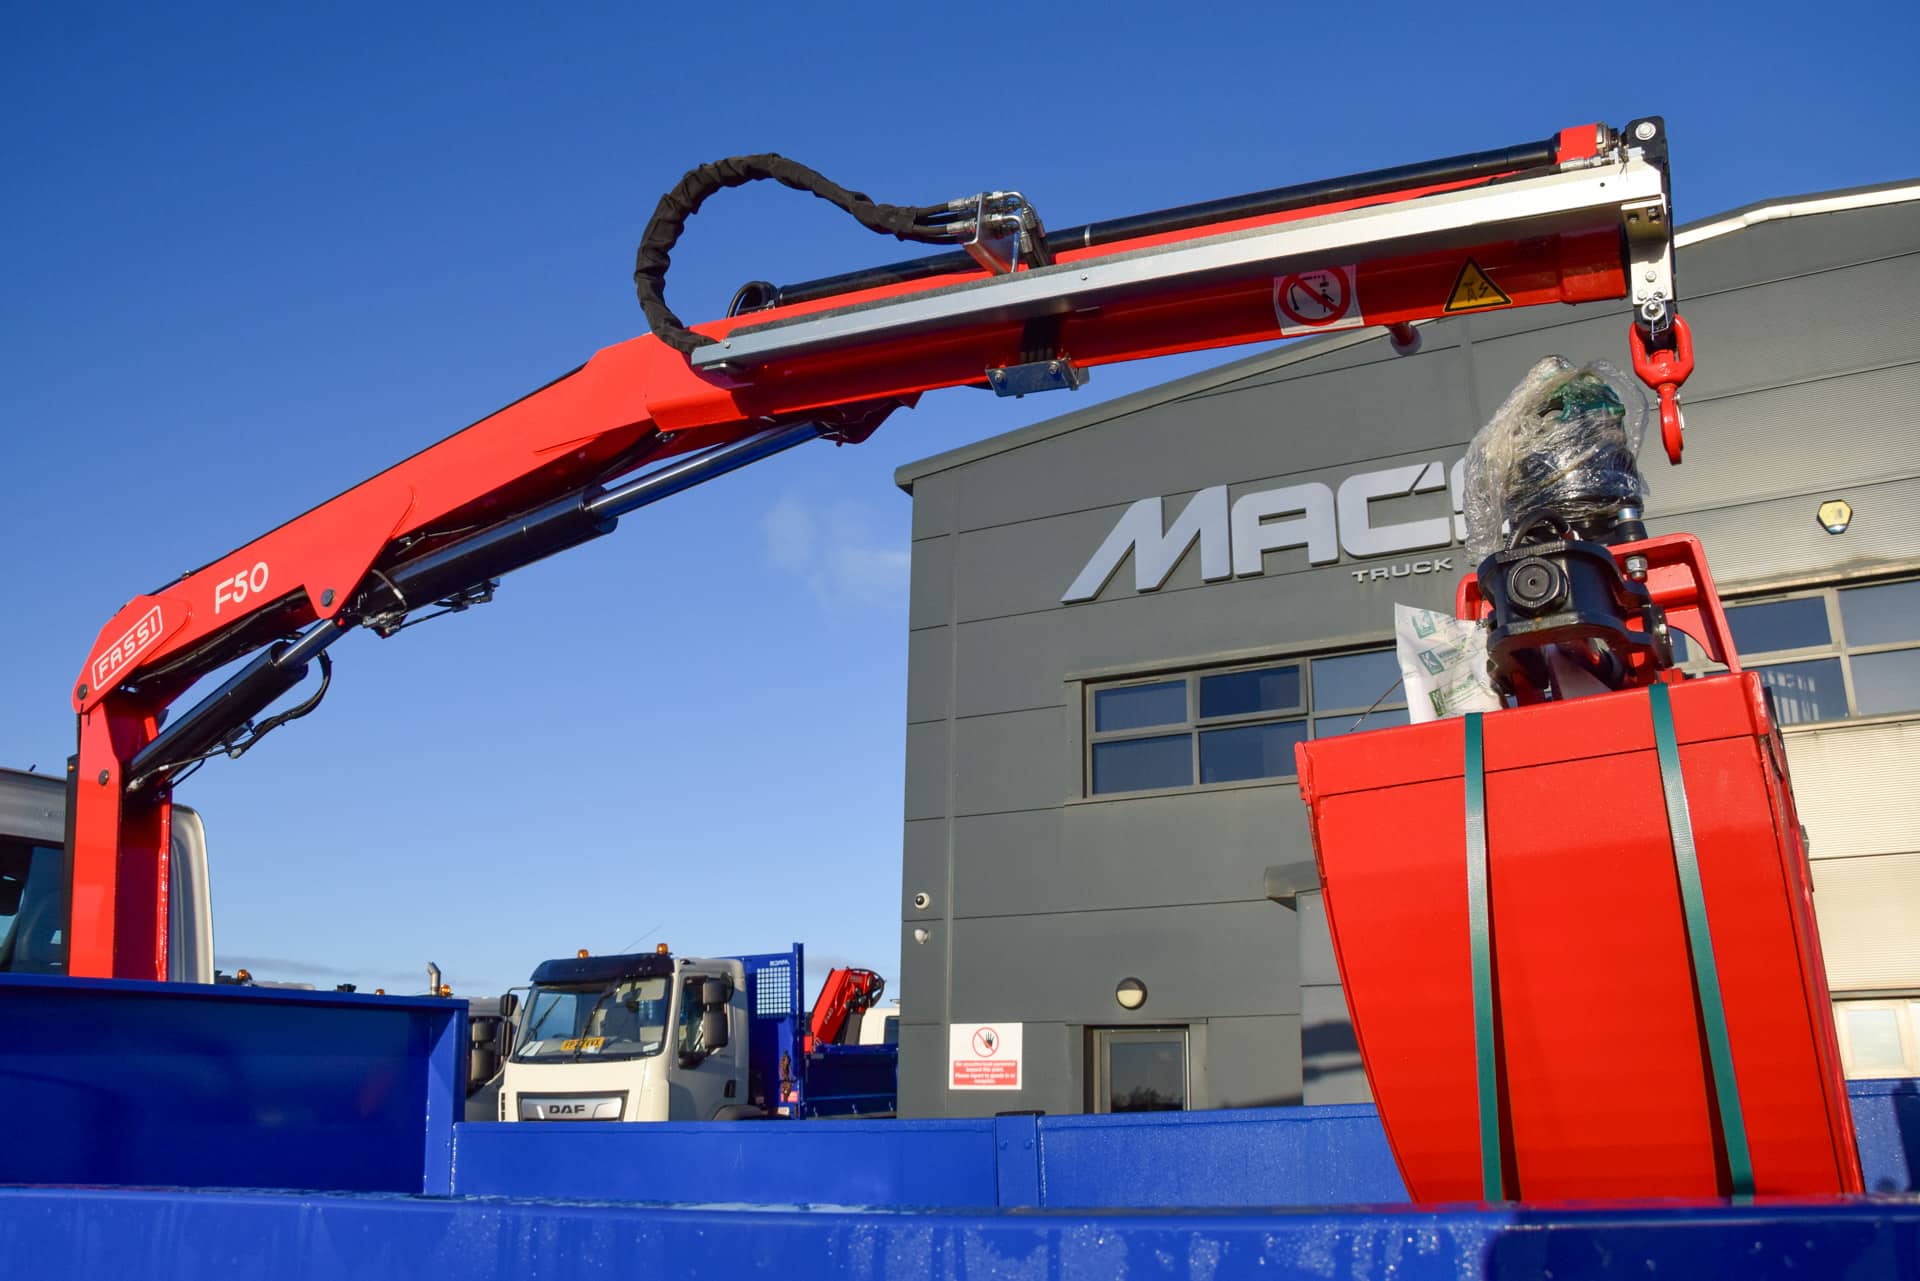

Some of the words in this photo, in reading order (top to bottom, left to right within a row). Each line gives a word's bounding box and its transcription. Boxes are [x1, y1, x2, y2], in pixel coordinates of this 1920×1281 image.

[1061, 457, 1468, 603] MAC
[214, 561, 269, 615] F50
[1351, 557, 1453, 583] TRUCK
[98, 615, 156, 681] FASSI
[548, 1104, 586, 1115] DAF
